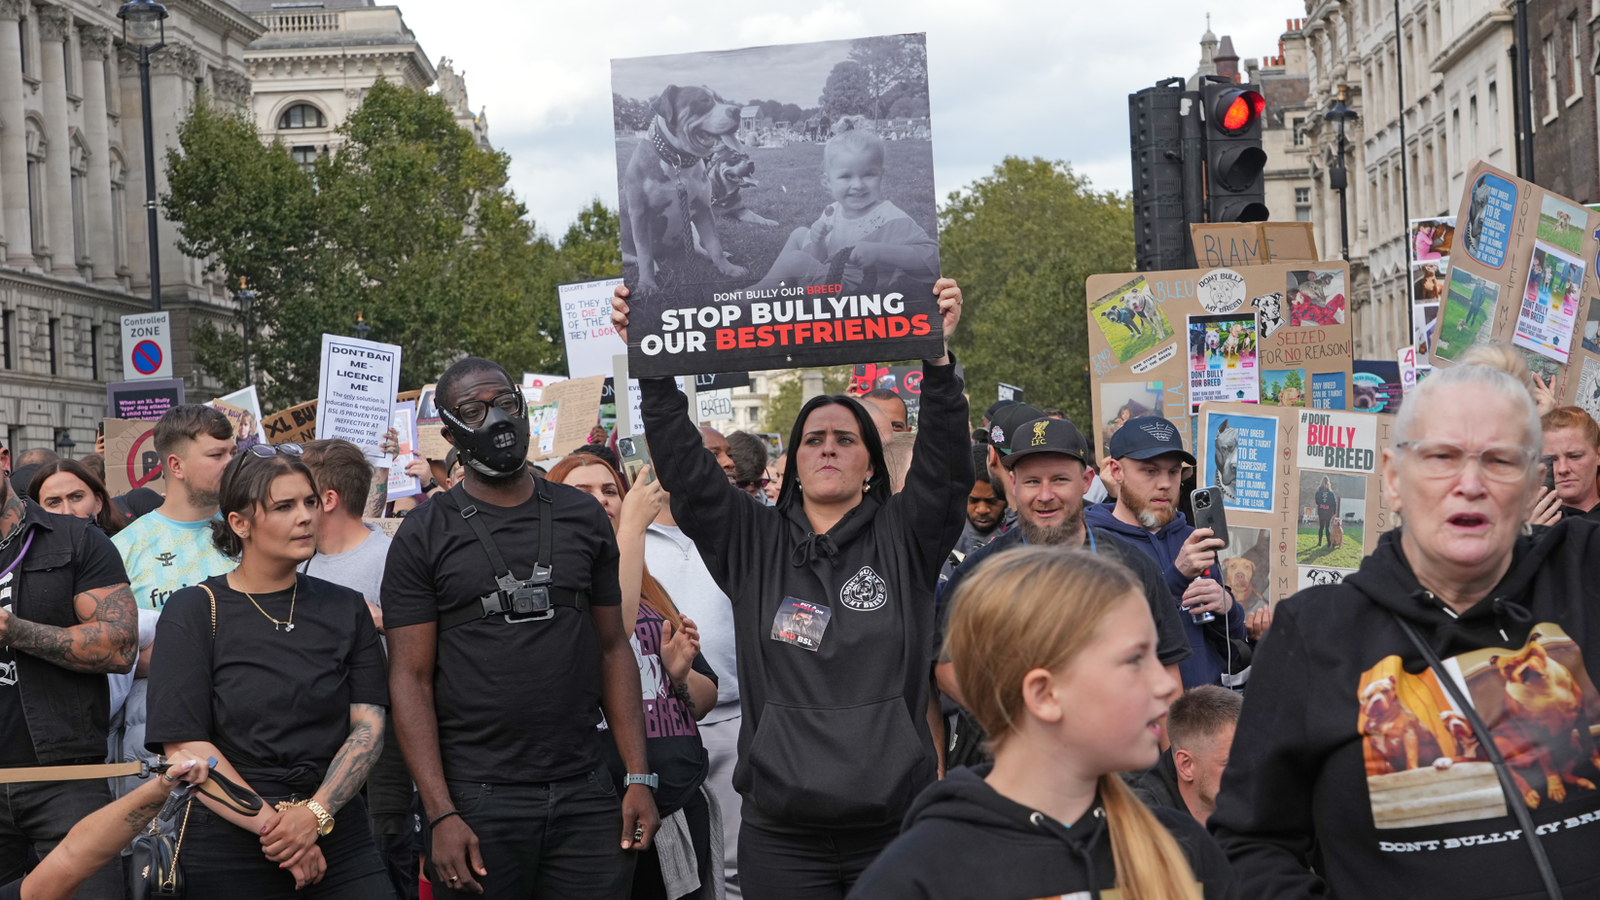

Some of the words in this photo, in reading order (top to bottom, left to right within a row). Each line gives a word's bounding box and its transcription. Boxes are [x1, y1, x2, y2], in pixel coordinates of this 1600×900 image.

[1516, 184, 1531, 248] DONT
[1198, 274, 1218, 288] DONT
[1221, 273, 1244, 283] BULLY
[1506, 253, 1517, 298] LET
[714, 291, 742, 302] DONT
[746, 288, 778, 300] BULLY
[781, 286, 804, 296] OUR
[807, 284, 842, 295] BREED
[1156, 279, 1194, 302] BLEU
[578, 299, 600, 308] THEY
[1205, 303, 1216, 312] MY
[1220, 298, 1243, 312] BREED
[1523, 298, 1535, 310] DONT
[1535, 302, 1548, 315] BULLY
[582, 309, 597, 317] DIE
[661, 305, 742, 331] STOP
[751, 292, 904, 324] BULLYING
[1521, 307, 1530, 319] OUR
[1530, 311, 1544, 324] BREED
[124, 315, 166, 326] Controlled
[568, 320, 579, 329] OF
[583, 317, 605, 327] THE
[1499, 306, 1509, 336] MY
[130, 326, 160, 338] ZONE
[568, 330, 587, 340] THEY
[592, 327, 616, 338] LOOK
[640, 331, 707, 356] OUR
[716, 314, 930, 350] BESTFRIENDS
[1277, 330, 1326, 346] SEIZED
[367, 352, 391, 362] BAN
[1092, 348, 1111, 368] END
[1259, 348, 1284, 365] FOR
[1285, 348, 1301, 361] NO
[1305, 340, 1350, 360] REASON!
[350, 360, 367, 369] ME
[1095, 360, 1118, 380] BSL
[337, 370, 383, 383] LICENCE
[1207, 370, 1223, 378] BULLY
[351, 383, 368, 392] ME
[1204, 378, 1221, 387] BREED
[326, 400, 353, 408] education
[356, 395, 378, 403] solution
[1313, 399, 1321, 408] TO
[1323, 399, 1331, 409] BE
[701, 398, 731, 417] BREED
[346, 411, 370, 419] PROVEN
[1301, 413, 1330, 426] #DONT
[264, 416, 292, 438] XL
[334, 418, 371, 428] INEFFECTIVE
[335, 426, 364, 436] REDUCING
[1239, 428, 1249, 437] ANY
[1250, 429, 1265, 438] BREED
[1308, 424, 1356, 448] BULLY
[1238, 438, 1247, 446] CAN
[1255, 440, 1271, 448] TAUGHT
[1238, 447, 1247, 459] TO
[1249, 448, 1257, 460] BE
[1283, 425, 1294, 476] YOU
[1307, 445, 1323, 457] OUR
[1324, 446, 1374, 470] BREED
[1237, 461, 1268, 472] AGGRESSIVE.
[1247, 481, 1266, 489] BLAMING
[1245, 489, 1260, 498] WRONG
[1281, 483, 1291, 522] SIT
[1279, 528, 1289, 567] FOR
[860, 569, 880, 584] BULLY
[863, 594, 883, 608] BREED
[779, 631, 796, 640] END
[797, 636, 812, 646] BSL
[644, 699, 696, 738] BRE
[1444, 830, 1522, 849] BULLY
